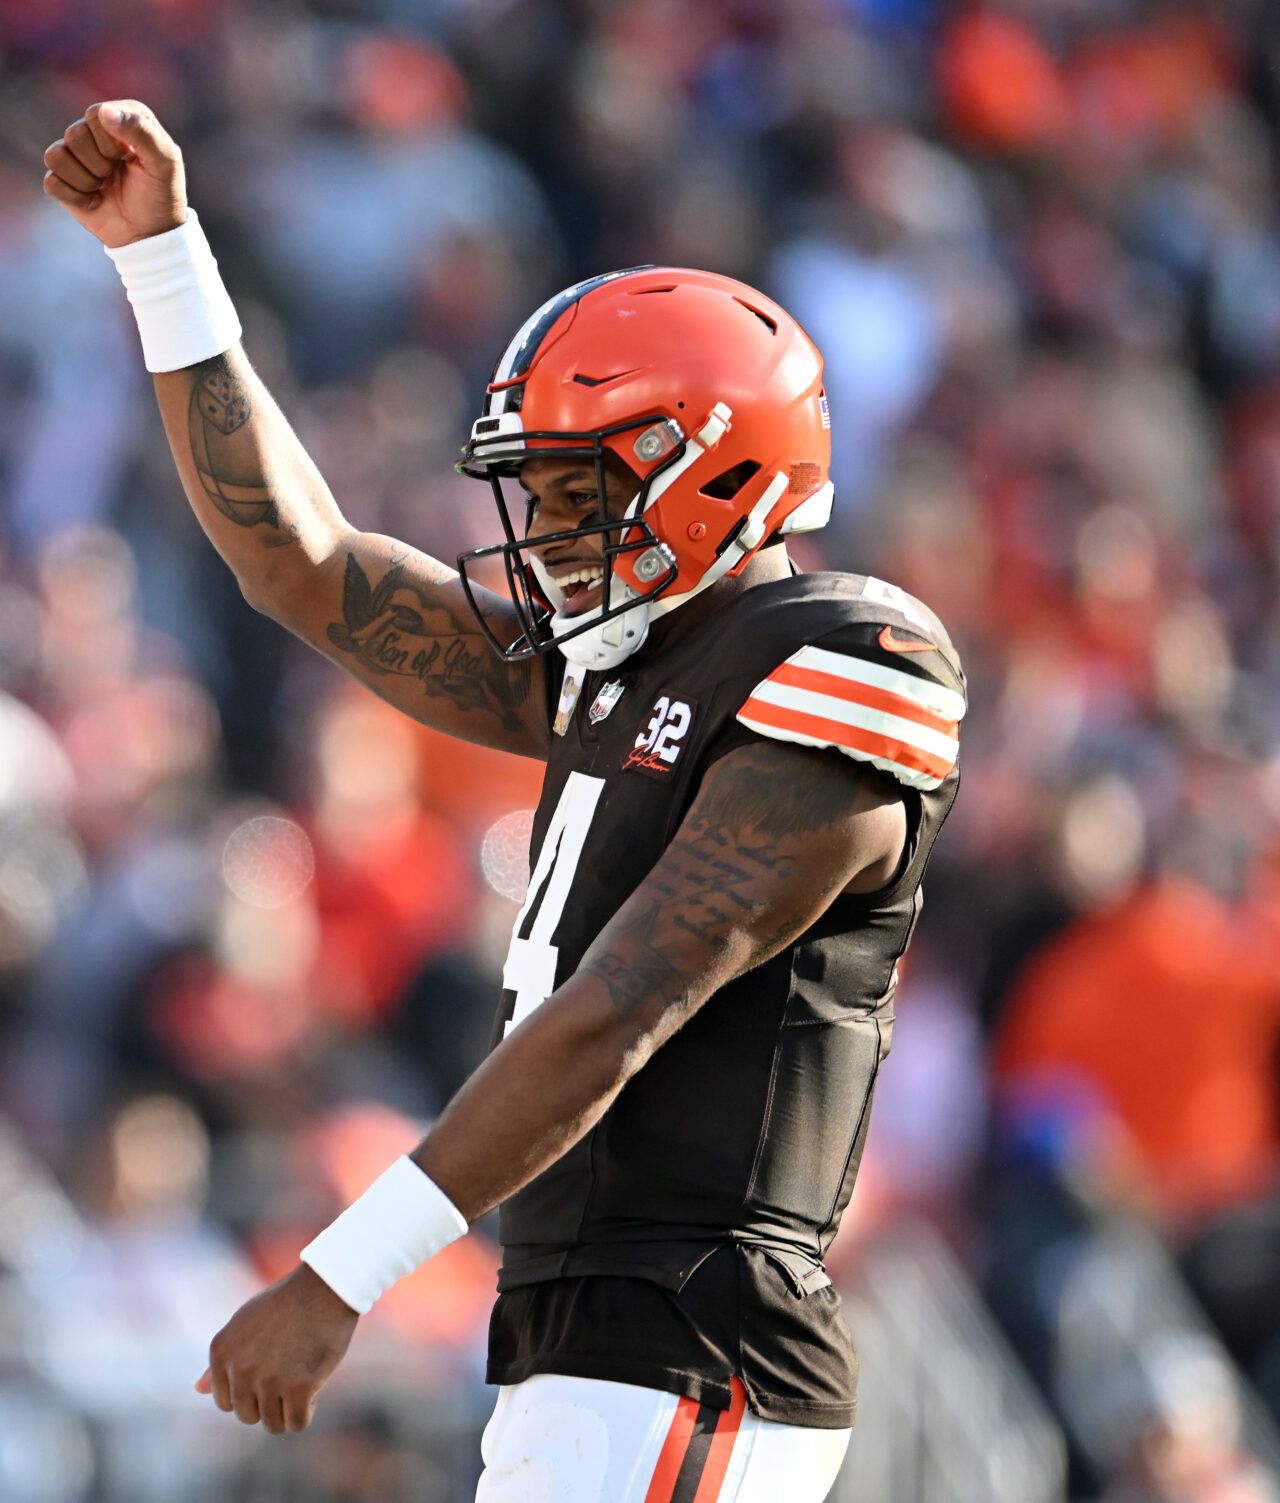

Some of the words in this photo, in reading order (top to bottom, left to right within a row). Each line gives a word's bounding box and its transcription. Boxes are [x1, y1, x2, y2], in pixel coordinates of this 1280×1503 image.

[411, 641, 440, 680] of
[634, 696, 692, 764] 32
[503, 771, 606, 1039] 4
